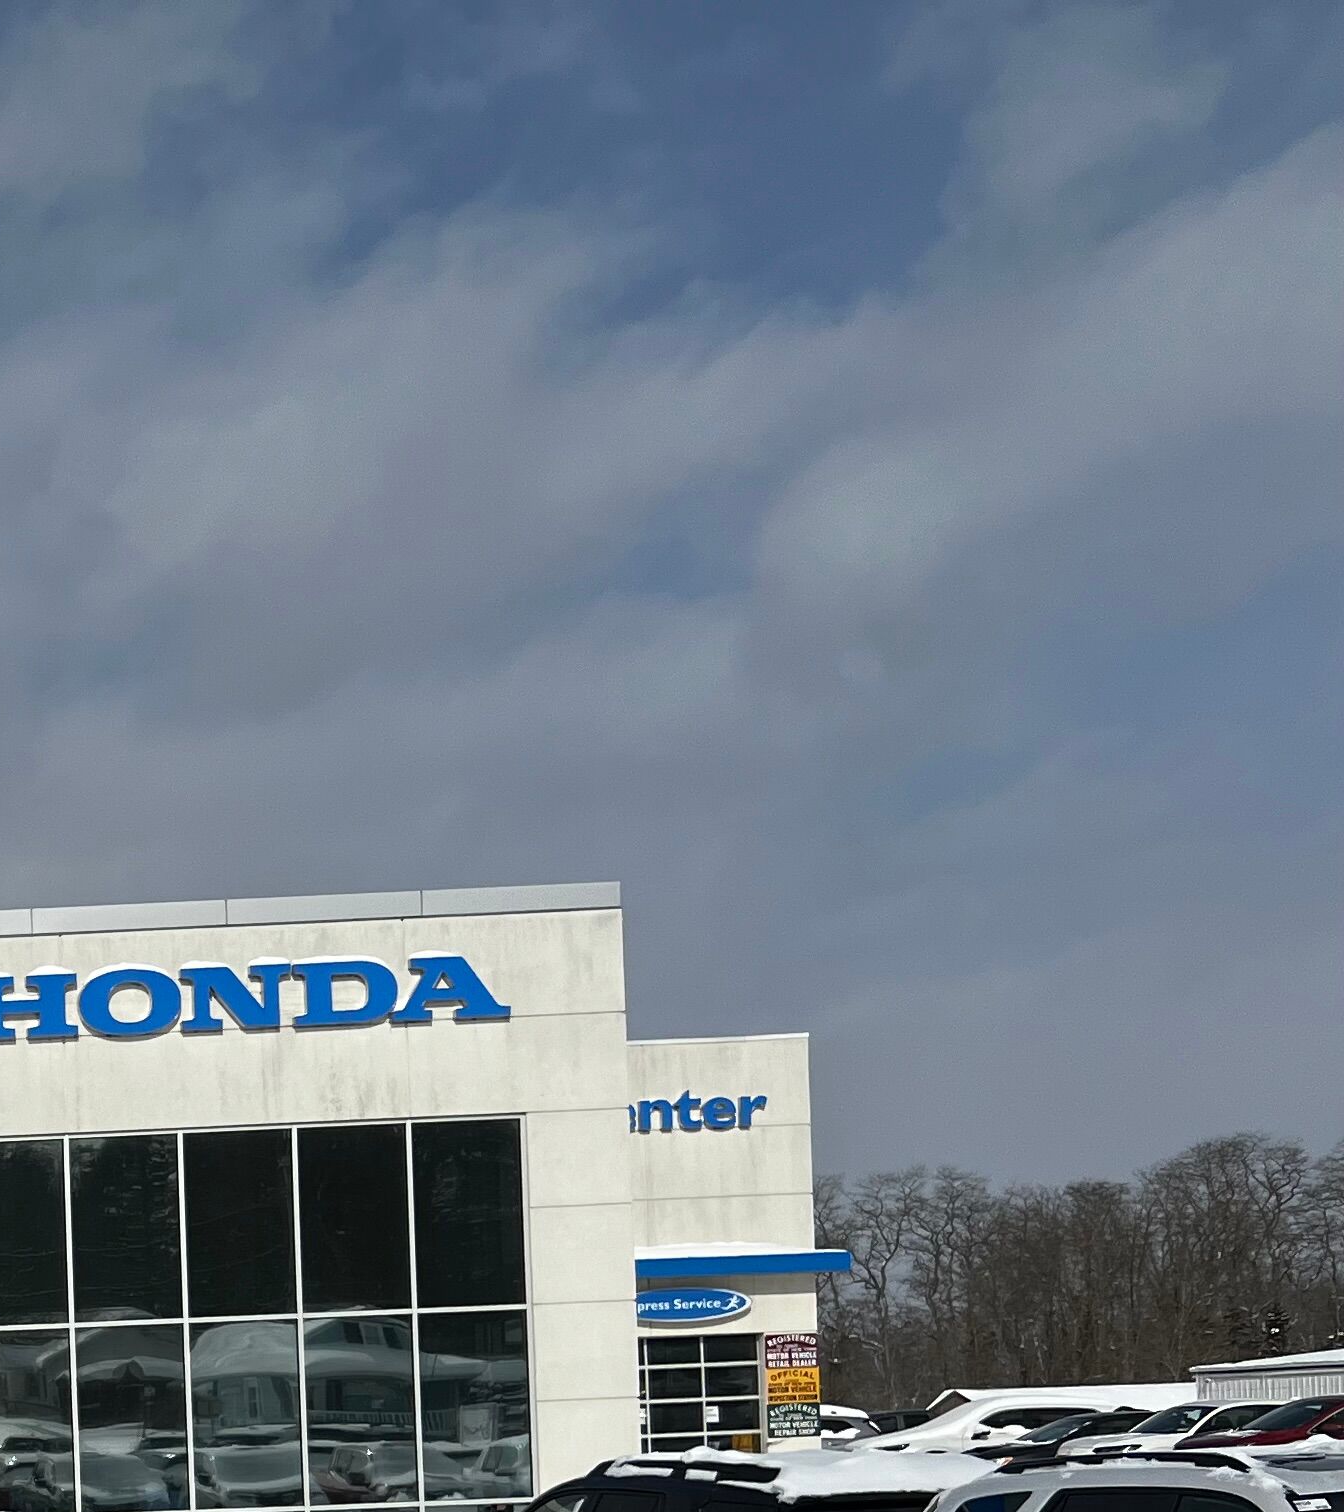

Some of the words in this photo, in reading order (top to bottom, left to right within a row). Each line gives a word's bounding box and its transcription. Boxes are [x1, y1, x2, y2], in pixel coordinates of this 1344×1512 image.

[629, 1090, 768, 1134] nter
[674, 1298, 722, 1310] Service
[767, 1334, 817, 1347] REGISTERED
[767, 1352, 789, 1360] MOTOR
[792, 1351, 817, 1359] VEHICLE
[770, 1370, 815, 1381] OFFICIAL
[769, 1403, 818, 1417] REGISTERED
[769, 1421, 791, 1429] MOTOR
